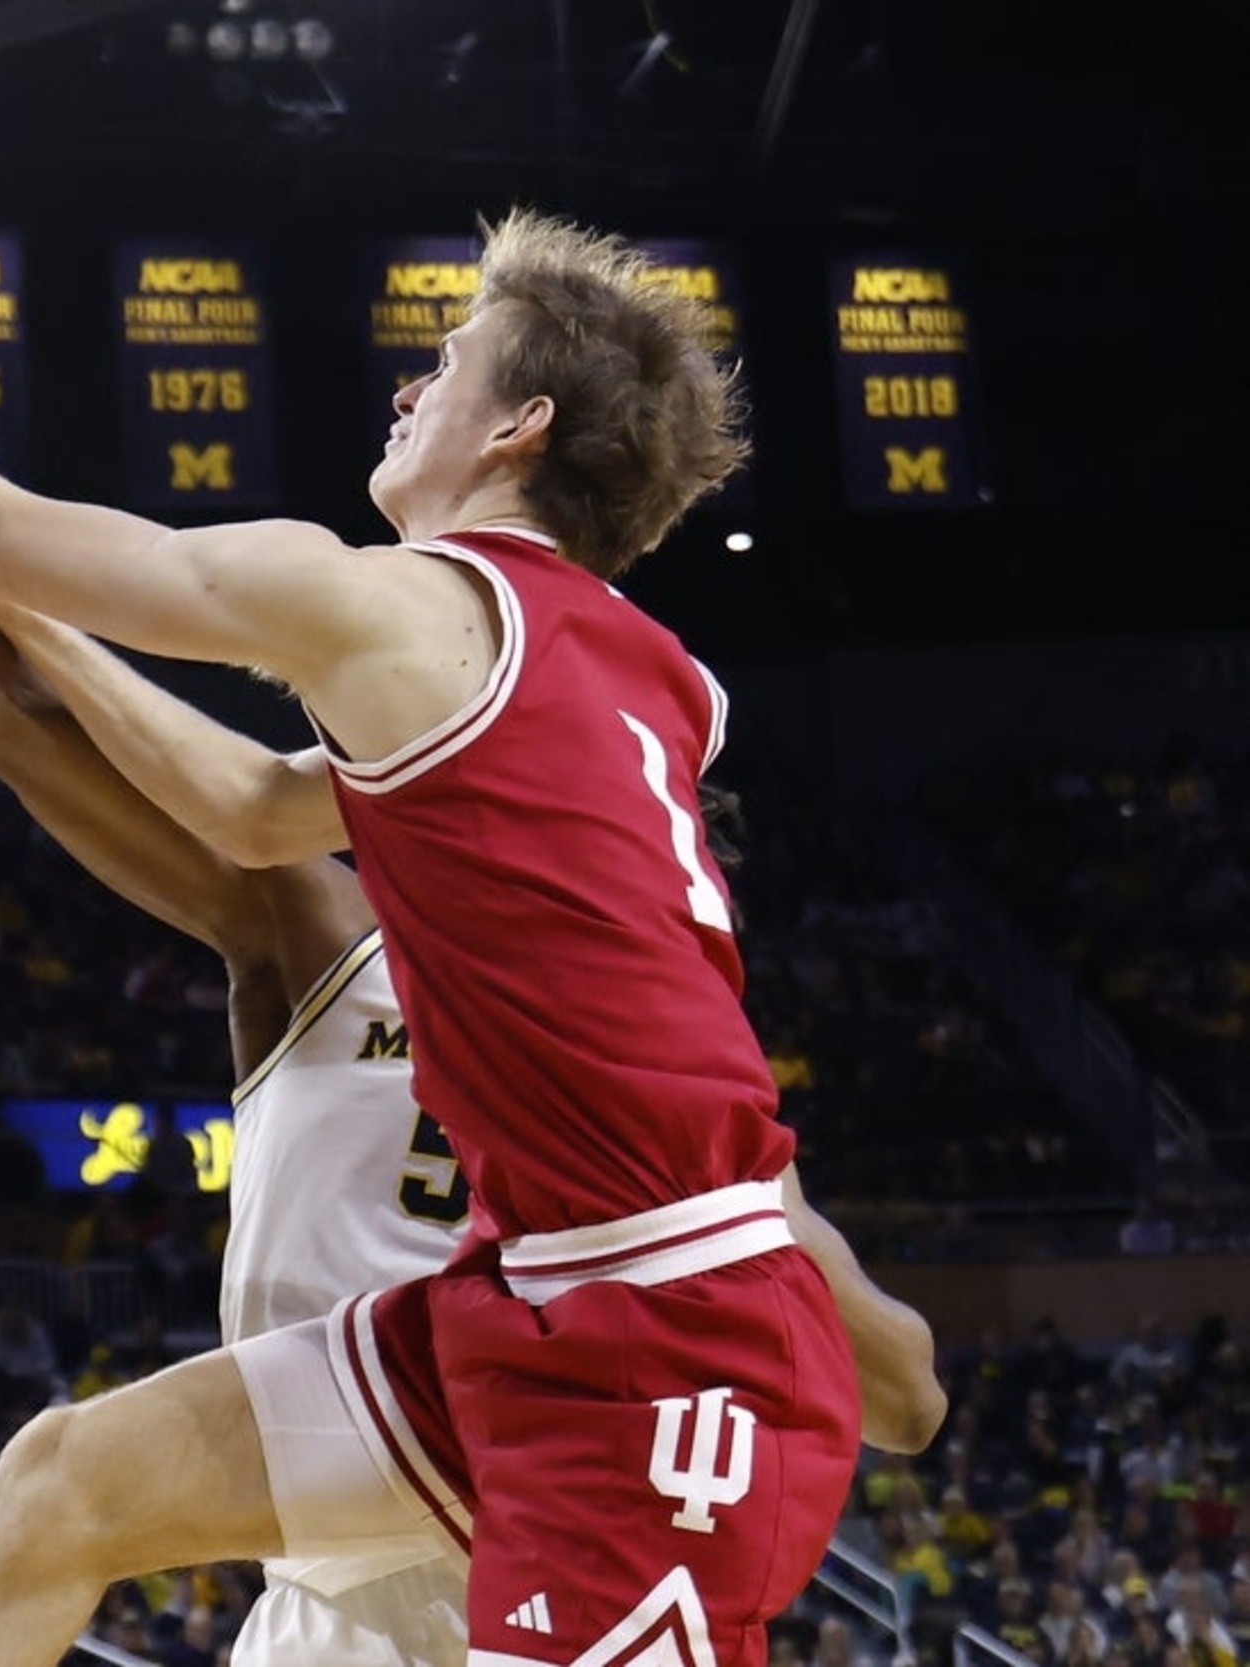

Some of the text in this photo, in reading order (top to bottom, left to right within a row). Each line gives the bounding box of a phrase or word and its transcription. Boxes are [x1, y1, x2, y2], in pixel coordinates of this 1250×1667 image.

[139, 258, 242, 294] NCAA
[853, 269, 950, 303] NCAA
[124, 296, 260, 326] FINAL FOUR
[837, 306, 967, 335] FINAL FOUR
[149, 370, 247, 412] 1976
[864, 375, 958, 418] 2018
[169, 442, 235, 491] M
[884, 446, 947, 493] M
[617, 709, 733, 933] 1
[397, 1107, 472, 1227] 5
